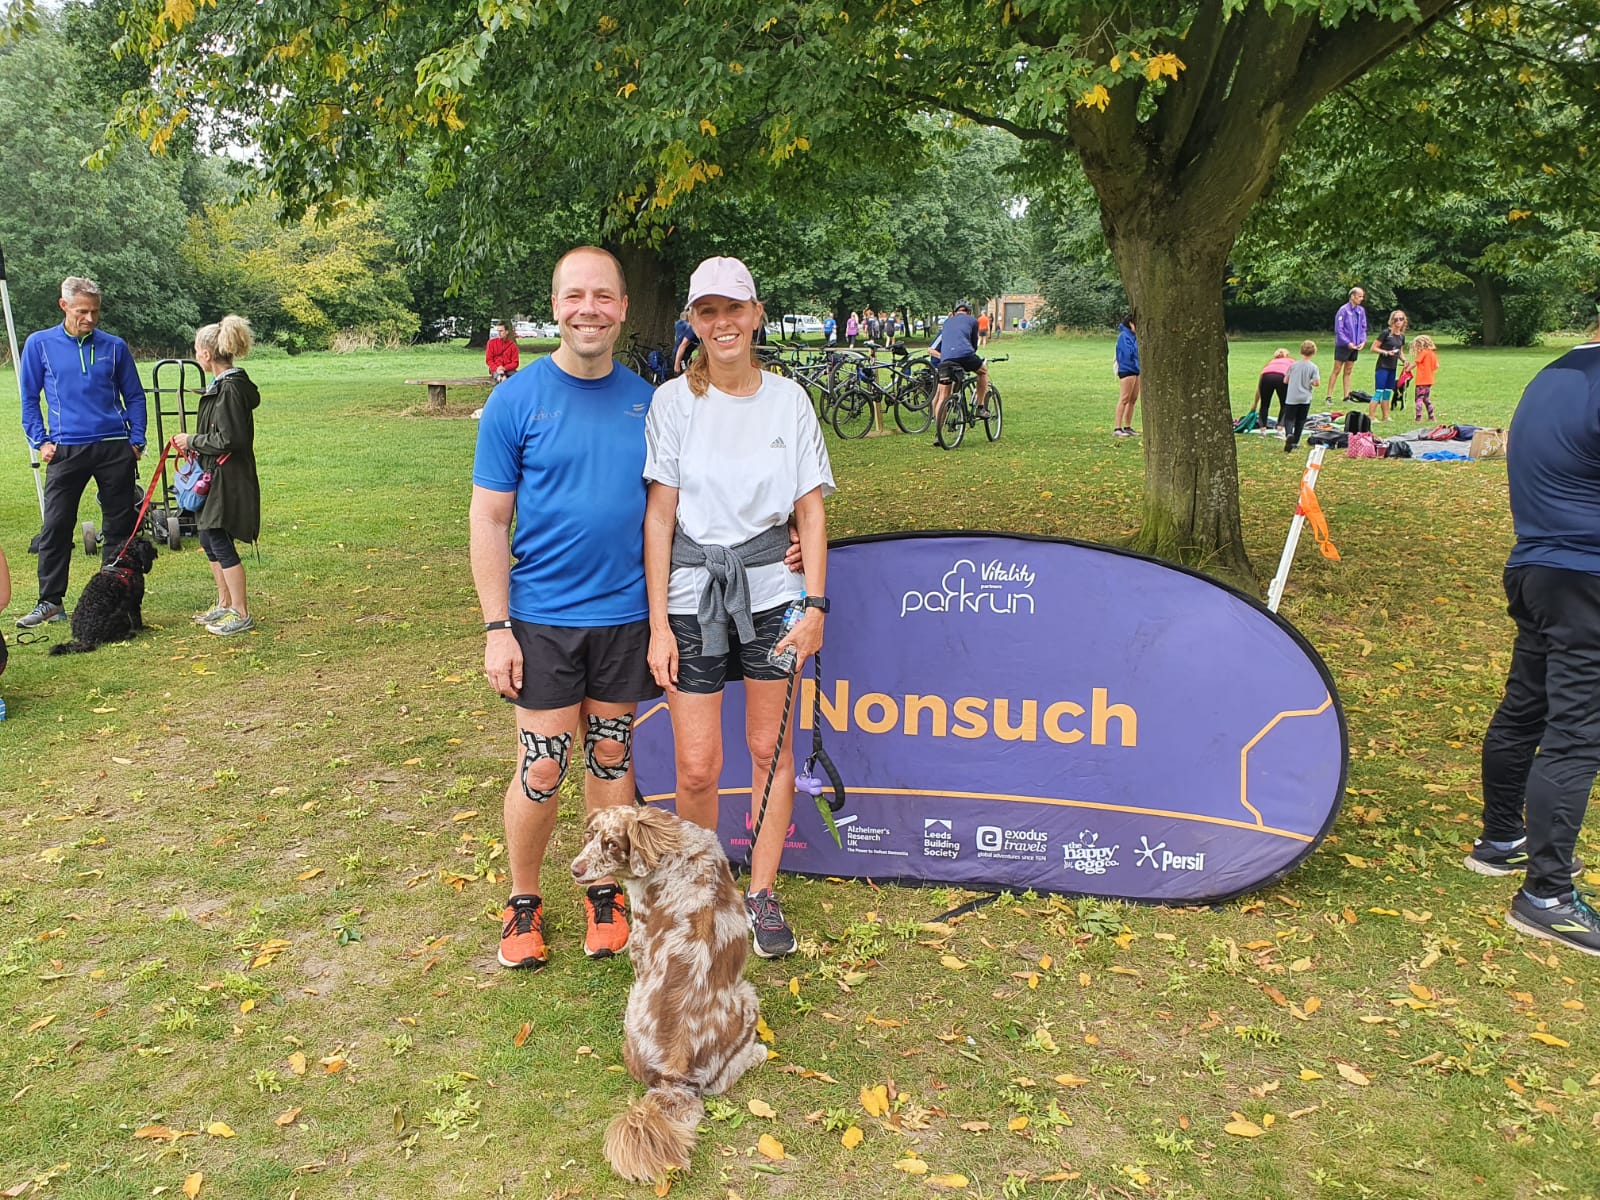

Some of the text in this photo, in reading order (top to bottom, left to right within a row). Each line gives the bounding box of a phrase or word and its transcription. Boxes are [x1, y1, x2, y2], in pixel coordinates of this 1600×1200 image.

[981, 559, 1036, 589] Vitality
[900, 573, 1035, 618] parkrun
[799, 678, 1138, 747] Nonsuch
[847, 825, 891, 835] Alzheimer's
[847, 832, 881, 841] Research
[924, 829, 952, 840] Leeds
[1004, 829, 1048, 842] exodus
[924, 838, 961, 851] Building
[1004, 839, 1048, 853] travels
[1068, 841, 1083, 849] the
[923, 847, 959, 860] Society
[1062, 844, 1120, 862] happy
[1074, 859, 1106, 875] egg
[1161, 850, 1205, 872] Persil
